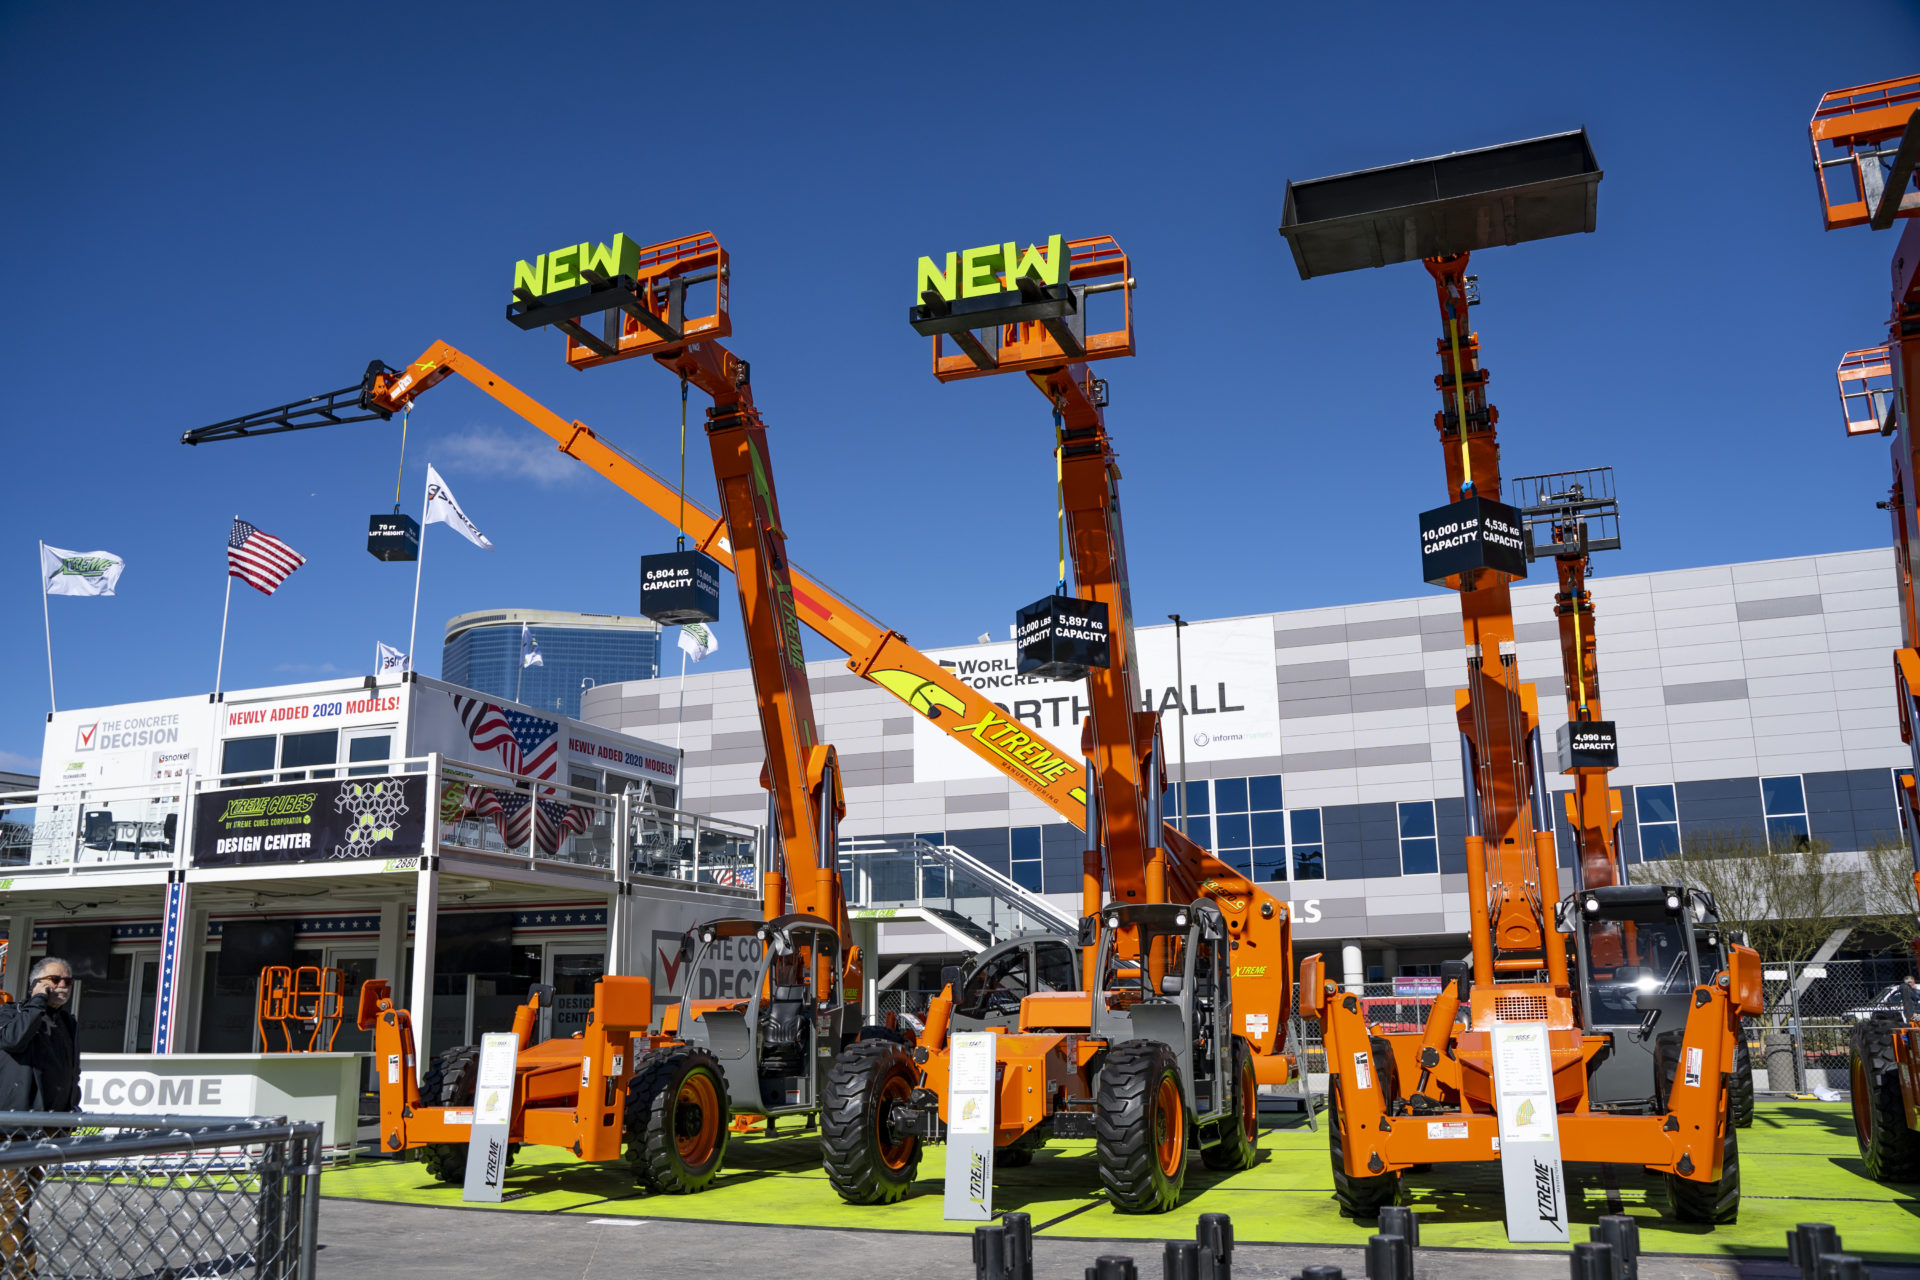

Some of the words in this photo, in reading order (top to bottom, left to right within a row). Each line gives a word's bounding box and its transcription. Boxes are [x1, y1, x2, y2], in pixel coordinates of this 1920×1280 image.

[513, 232, 624, 303] NEW
[917, 234, 1061, 305] NEW
[1422, 522, 1458, 541] 10,000
[1461, 518, 1478, 530] LBS
[1485, 518, 1507, 533] 4,536
[1509, 526, 1520, 536] KG
[1424, 530, 1478, 554] CAPACITY
[1483, 531, 1524, 550] CAPACITY
[642, 578, 693, 591] CAPACITY
[646, 568, 675, 580] 6,804
[696, 579, 719, 598] CAPACITY
[1018, 619, 1039, 637] 13,000
[1040, 616, 1051, 627] LBS
[1059, 614, 1088, 627] 5,897
[1091, 621, 1103, 630] KG
[1018, 628, 1051, 649] CAPACITY
[1055, 627, 1107, 643] CAPACITY
[958, 659, 1016, 675] WORL
[960, 674, 1056, 690] CONCRE
[229, 710, 267, 726] NEWLY
[270, 705, 309, 722] ADDED
[313, 702, 342, 717] 2020
[346, 696, 400, 715] MODELS!
[994, 694, 1090, 729] RTH
[1140, 682, 1244, 718] HALL
[102, 721, 122, 731] THE
[124, 714, 179, 729] CONCRETE
[100, 728, 179, 750] DECISION
[952, 710, 1077, 784] XTREME
[1213, 733, 1243, 742] informa
[1575, 734, 1599, 742] 4,990
[164, 752, 190, 762] snorkel
[569, 738, 596, 756] NEWLY
[597, 746, 623, 763] ADDED
[625, 752, 643, 767] 2020
[644, 758, 676, 776] MODELS!
[1001, 762, 1059, 804] MANUFACTURING
[218, 797, 270, 822] XTREME
[267, 793, 316, 815] CUBES
[253, 818, 269, 827] CUBES
[216, 836, 262, 855] DESIGN
[264, 832, 311, 851] CENTER
[703, 937, 733, 961] HE
[1232, 966, 1267, 979] XTREME
[558, 998, 594, 1009] DESIG
[558, 1012, 587, 1023] CENT
[83, 1078, 222, 1106] LCOME
[485, 1137, 498, 1195] XTREME
[969, 1149, 987, 1213] XTREME
[1533, 1156, 1563, 1233] XTREME
